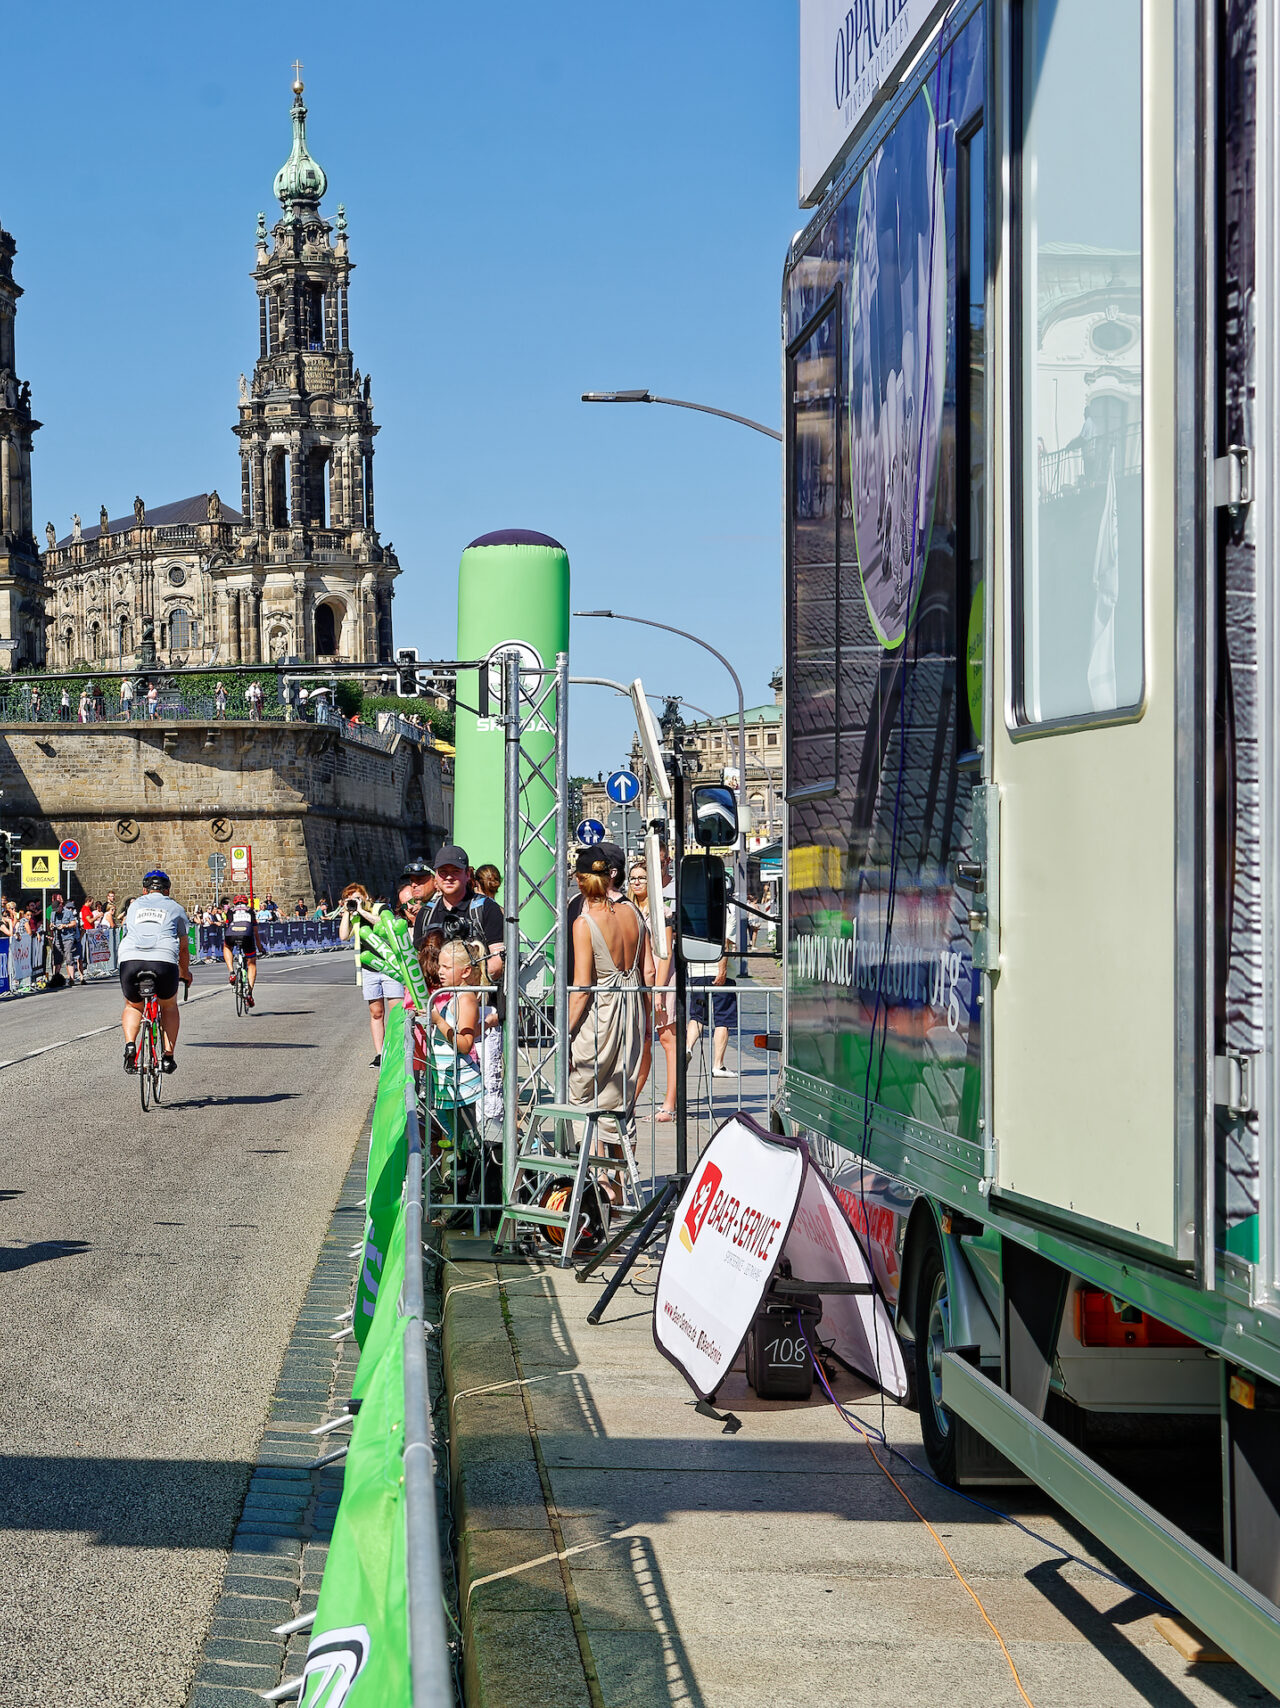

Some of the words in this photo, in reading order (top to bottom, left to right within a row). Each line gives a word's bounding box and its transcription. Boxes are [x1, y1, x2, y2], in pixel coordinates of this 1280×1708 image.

[796, 916, 962, 1033] www.sachsentour.org
[707, 1189, 782, 1261] BAER-SERVICE
[764, 1337, 808, 1362] 108
